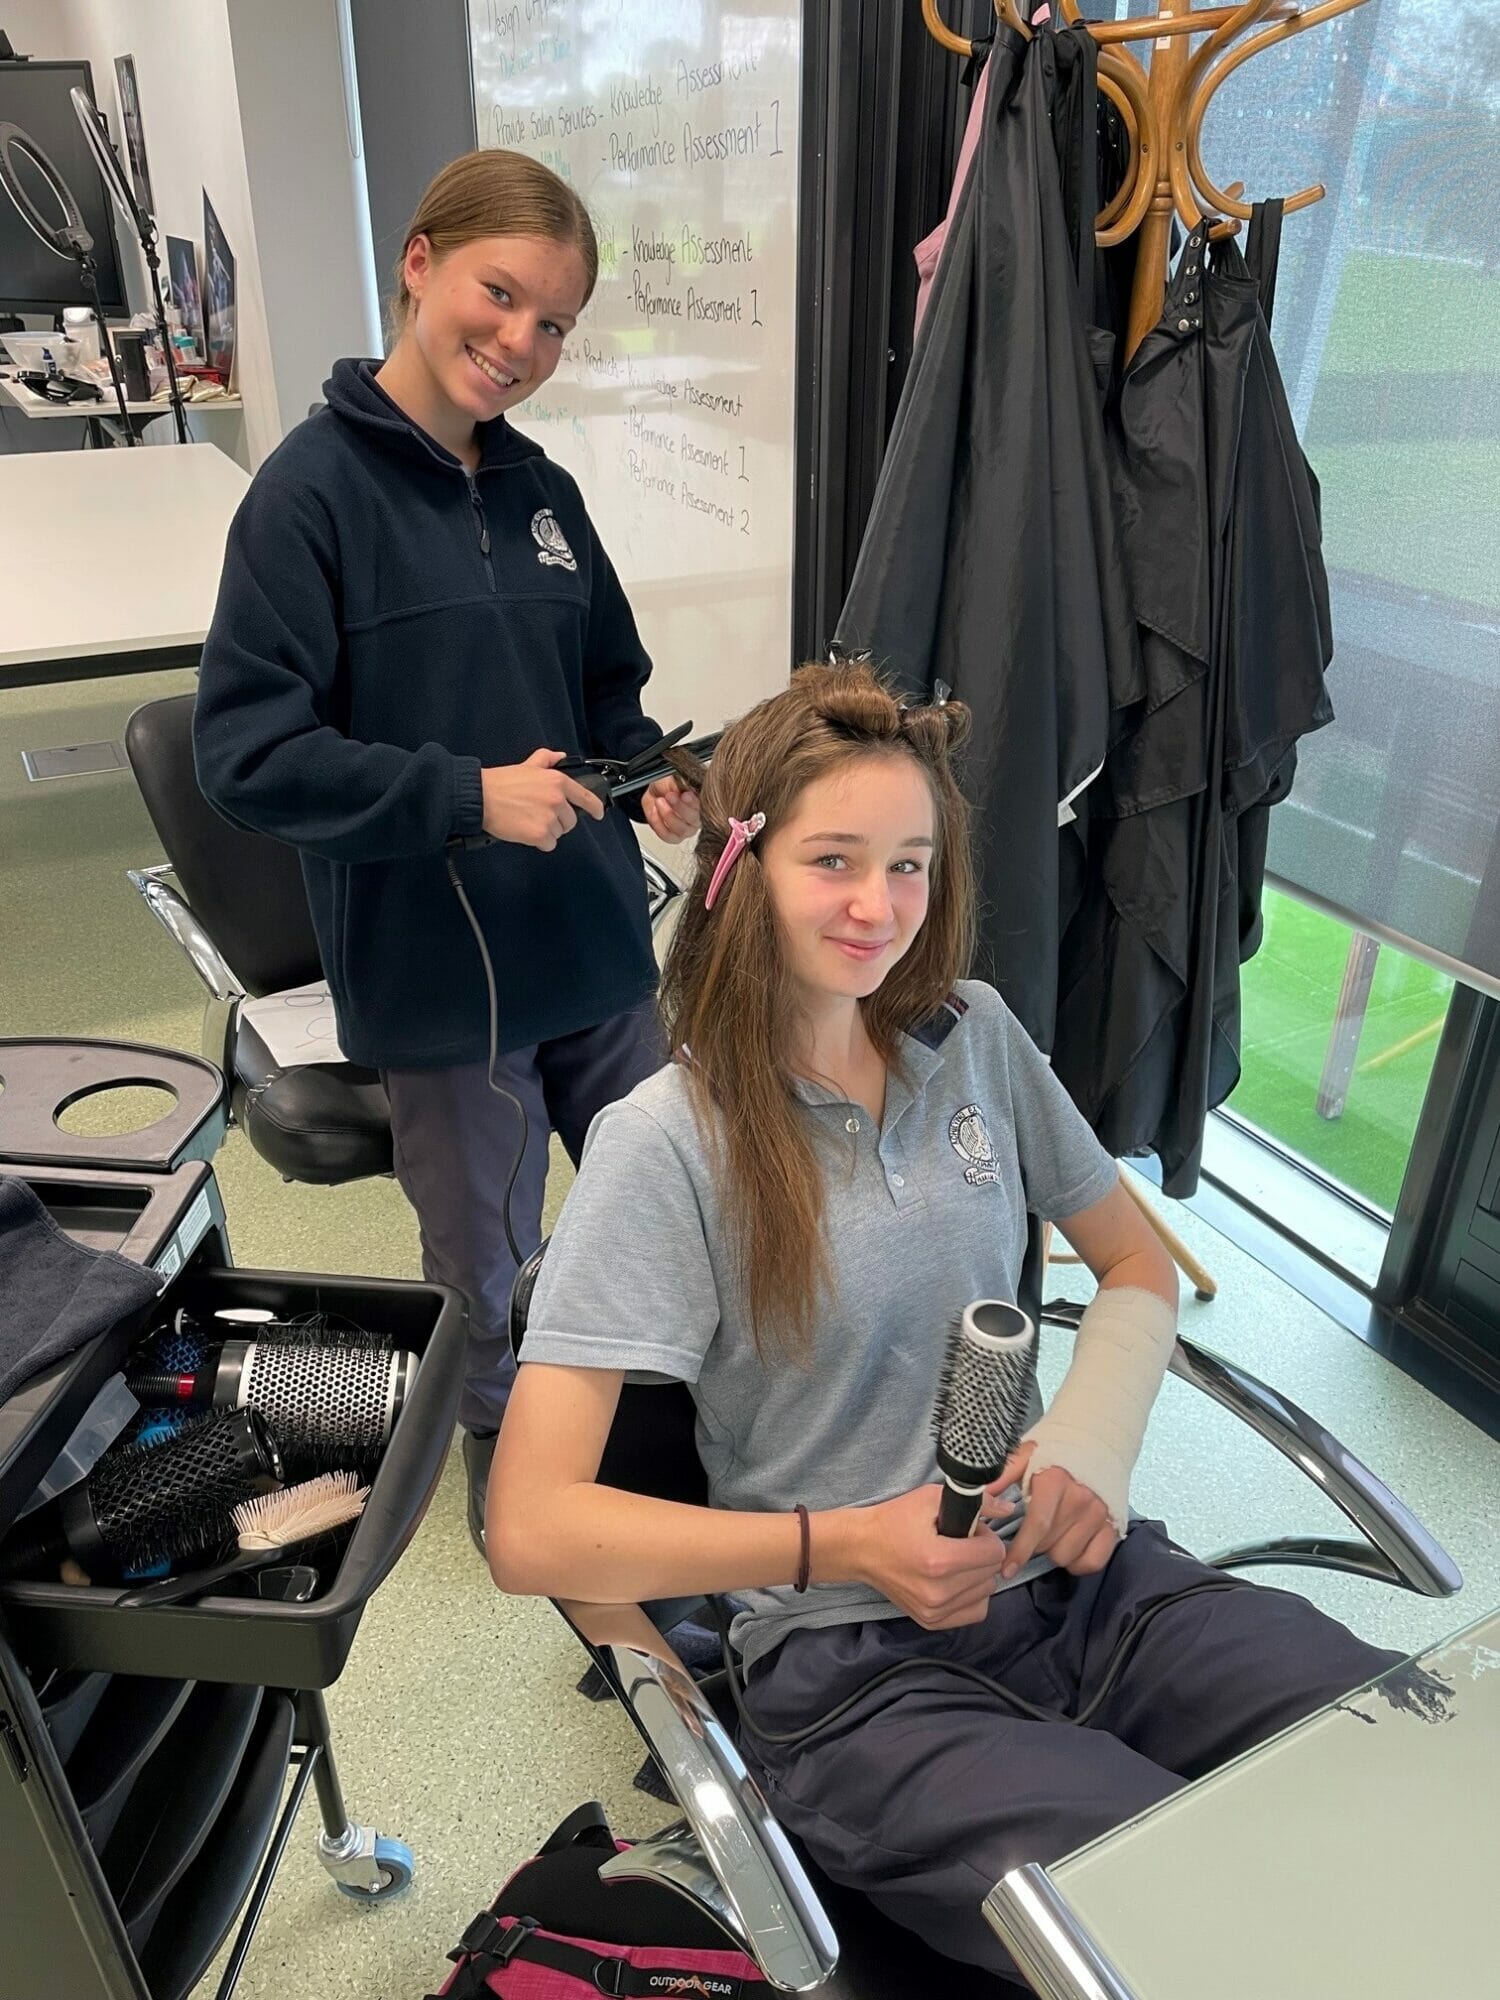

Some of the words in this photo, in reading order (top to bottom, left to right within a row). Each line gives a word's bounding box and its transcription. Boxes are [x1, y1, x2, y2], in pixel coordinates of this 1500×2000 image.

[610, 75, 663, 138] Knowledge
[609, 132, 676, 189] Performance
[683, 111, 762, 169] Assessment
[632, 224, 676, 285] Knowledge
[681, 224, 753, 265] Assessment
[632, 269, 683, 328] Performance
[687, 287, 742, 324] Assessment
[683, 378, 743, 417] Assessment
[628, 405, 675, 454] Performance
[681, 433, 729, 476] Assessment
[681, 481, 735, 529] Assessment
[739, 509, 750, 536] 2
[649, 1975, 700, 1989] OUTDOOR
[703, 1981, 732, 1995] GEAR
